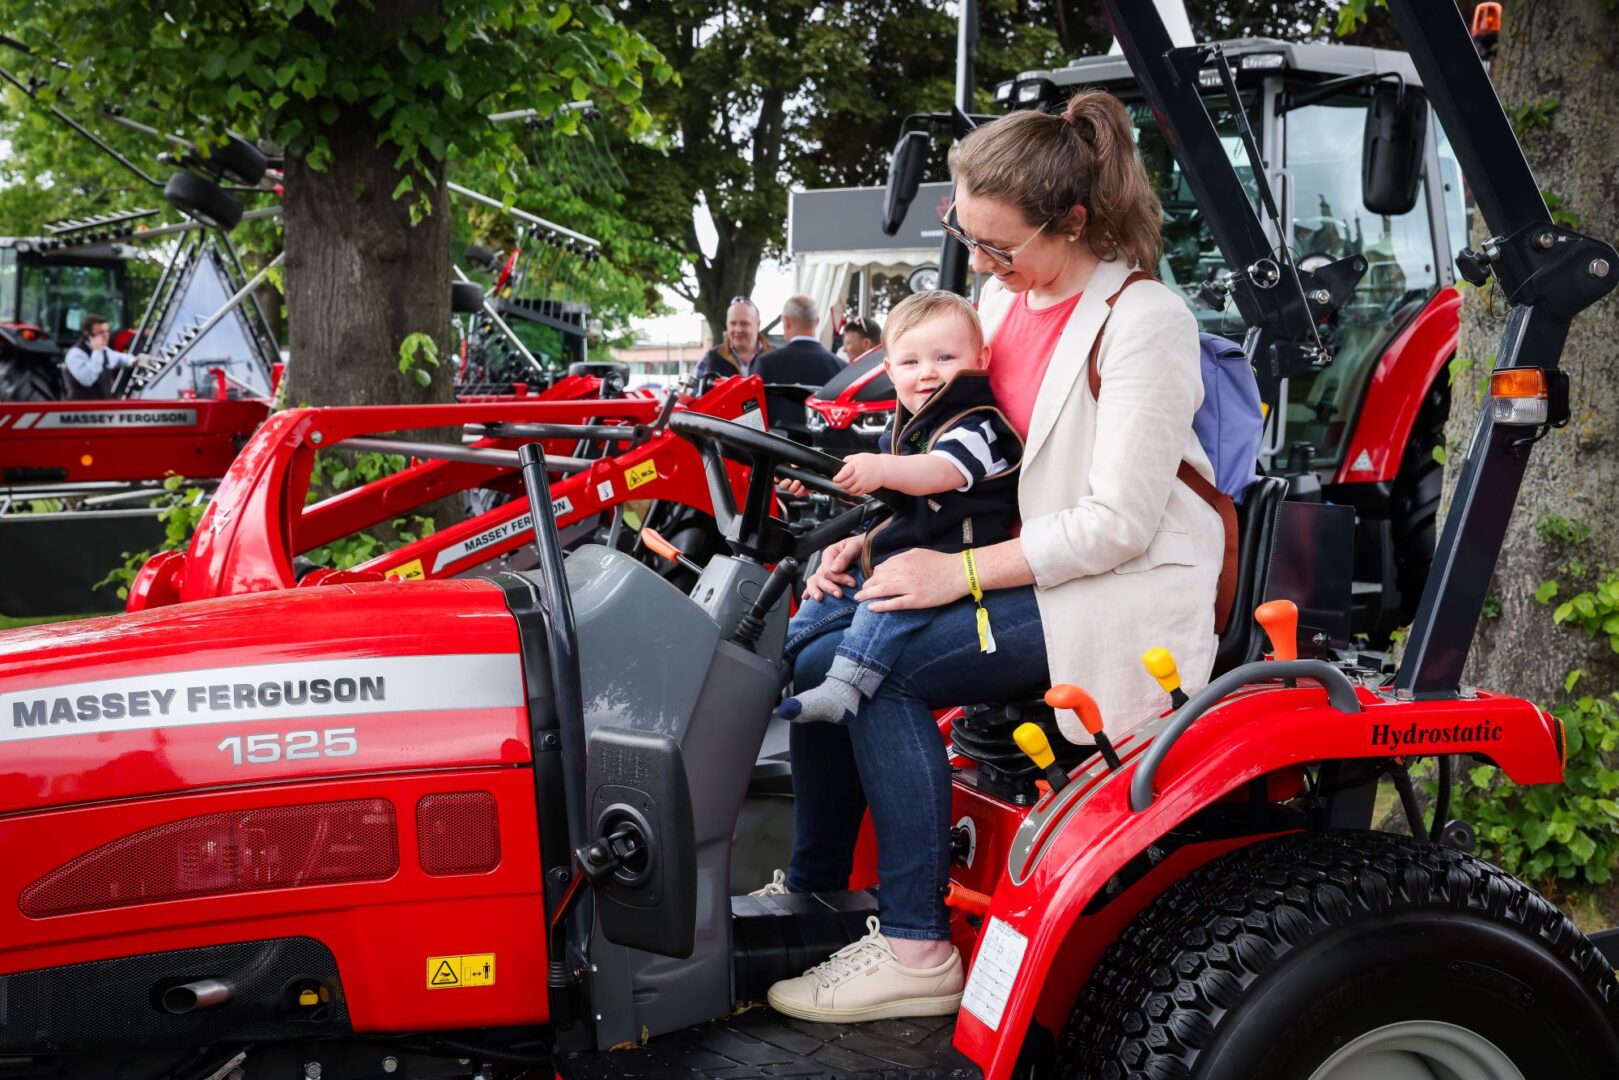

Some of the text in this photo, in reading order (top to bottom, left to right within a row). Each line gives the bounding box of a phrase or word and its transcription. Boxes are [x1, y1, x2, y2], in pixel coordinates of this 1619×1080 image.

[59, 412, 187, 424] MASSEY FERGUSON
[464, 525, 508, 552] MASSEY
[966, 556, 974, 576] MEMBER
[13, 676, 385, 727] MASSEY FERGUSON
[216, 727, 358, 766] 1525
[1371, 720, 1503, 750] Hydrostatic
